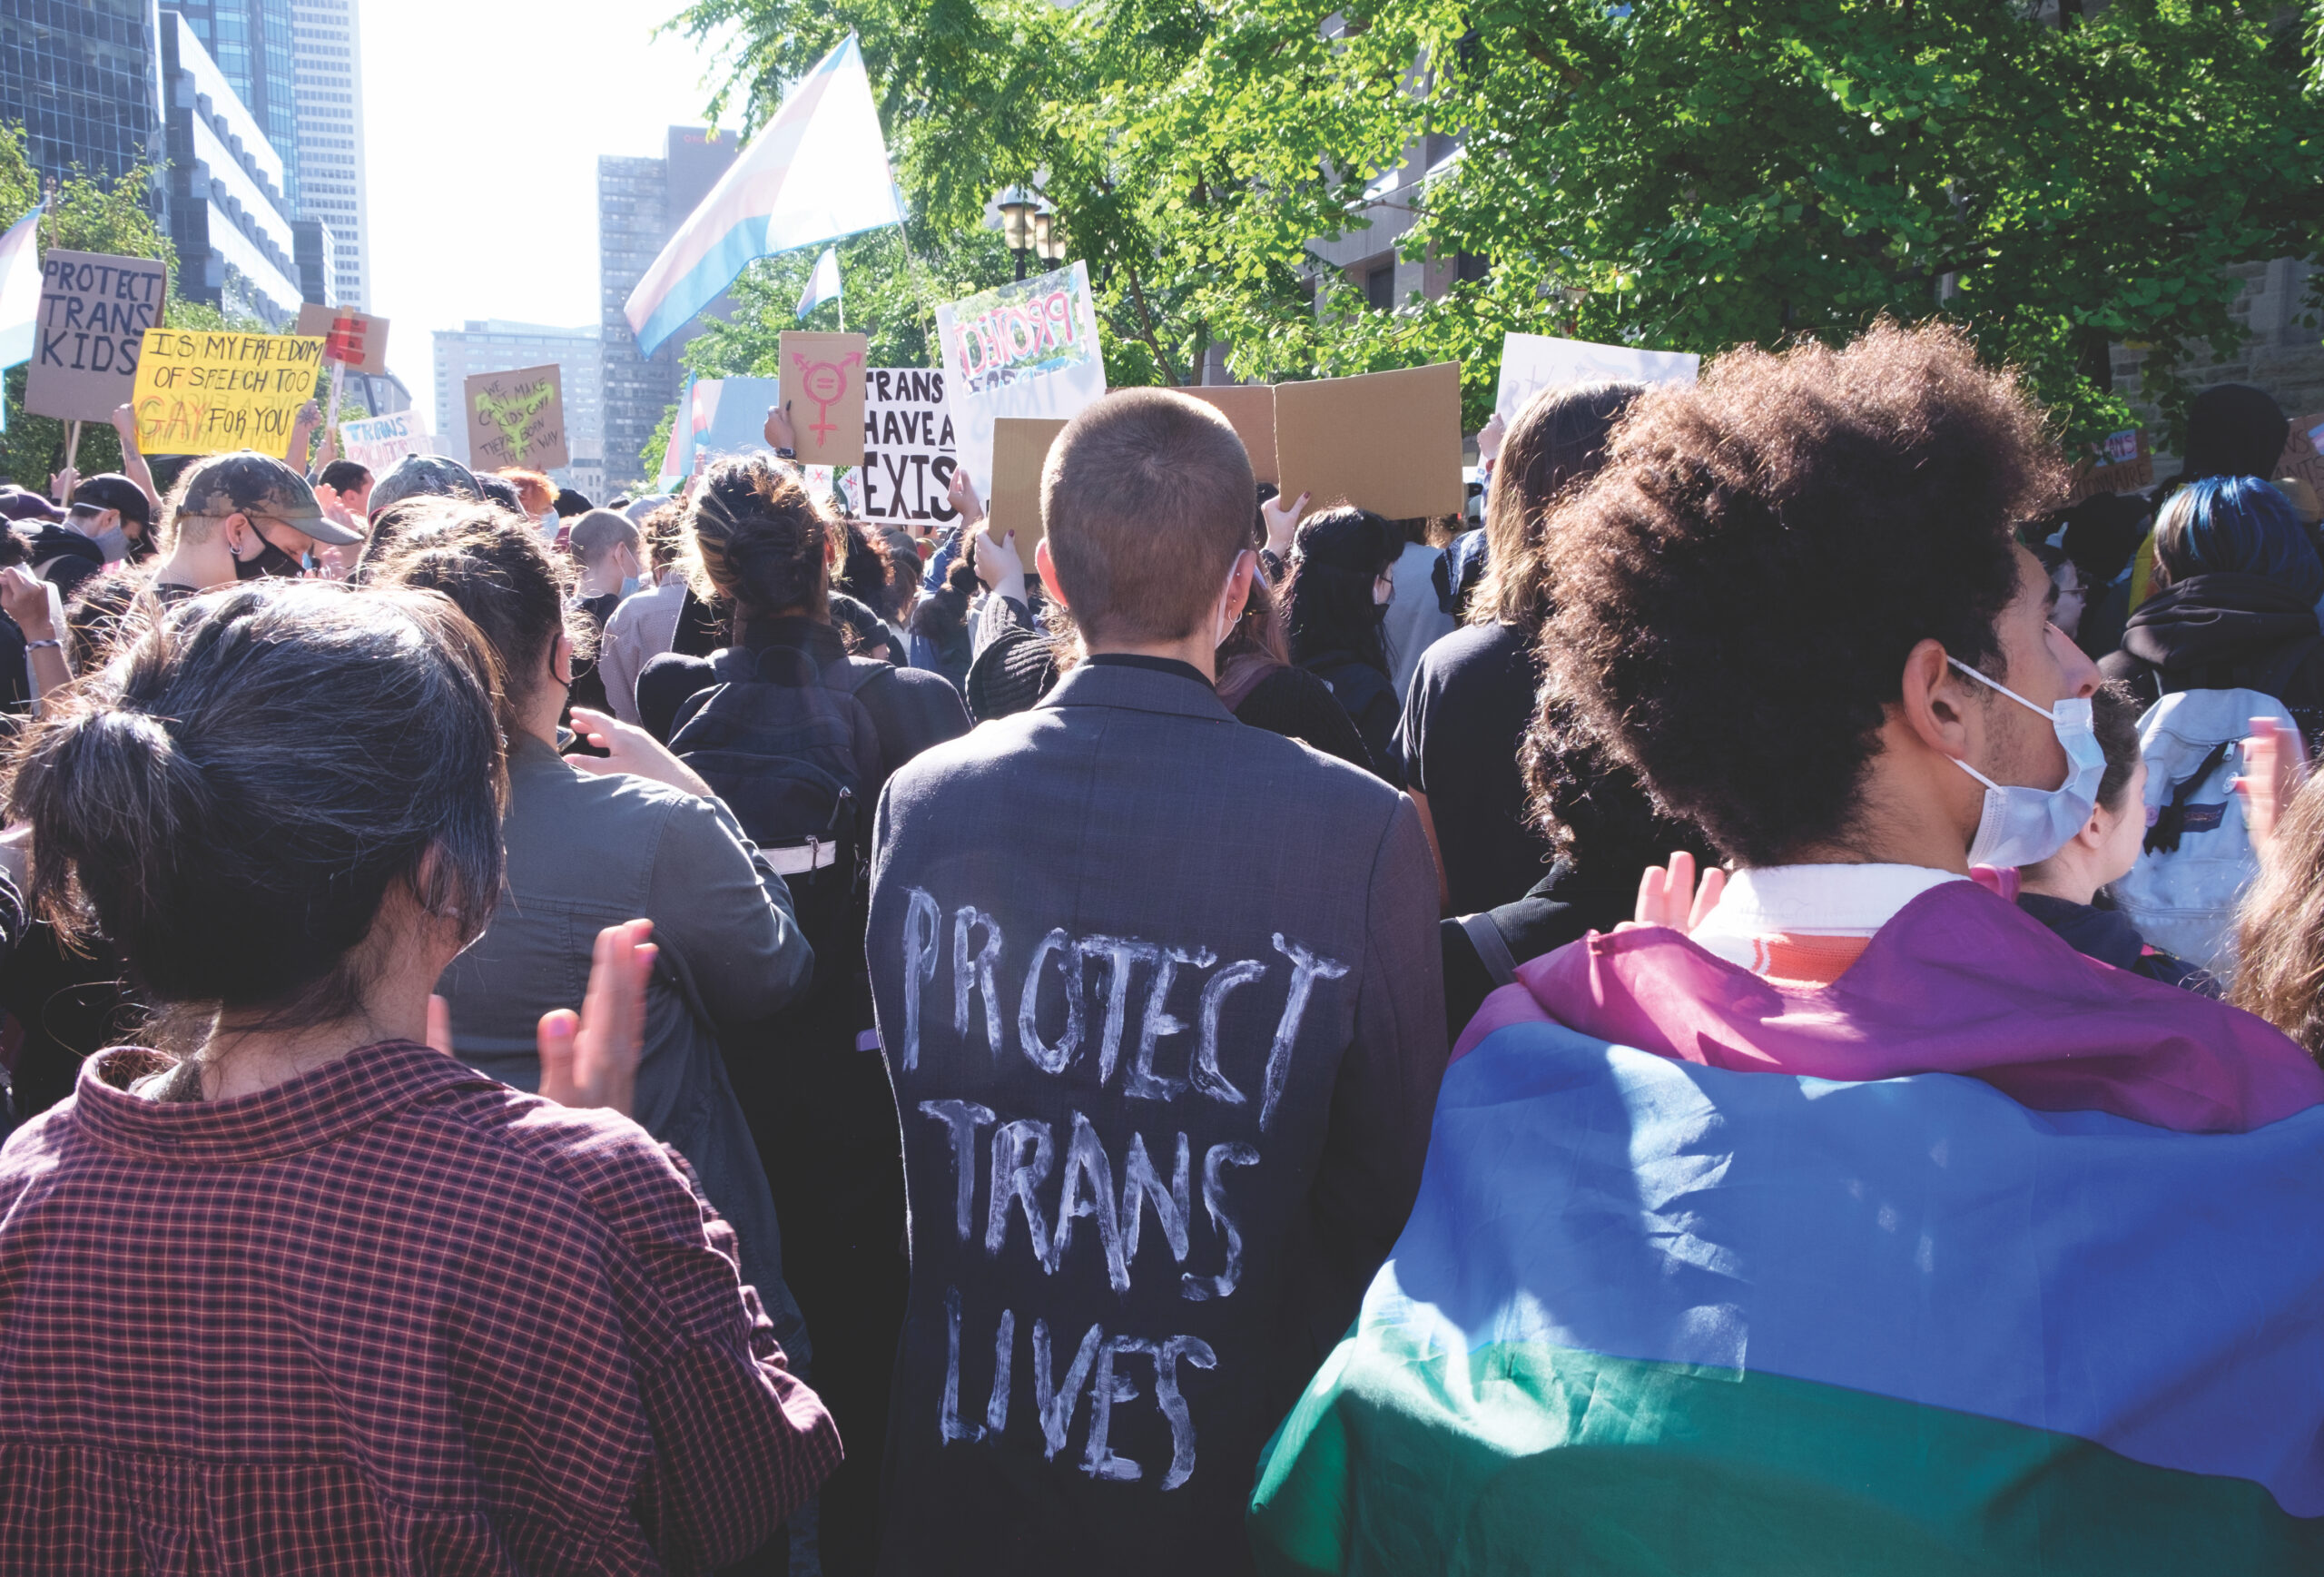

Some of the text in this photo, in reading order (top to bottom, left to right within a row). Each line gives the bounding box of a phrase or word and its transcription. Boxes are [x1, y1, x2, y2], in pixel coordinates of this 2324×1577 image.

[43, 260, 162, 301] PROTECT
[42, 293, 154, 337] TRANS
[41, 328, 139, 376] KIDS
[149, 332, 325, 367] IS MY FREEDOM
[153, 366, 310, 393] OF SPEECH TOO
[483, 379, 504, 397] WE
[514, 377, 546, 403] MAKE
[134, 395, 211, 441] GAY
[208, 408, 247, 439] FOR
[346, 417, 408, 441] TRANS
[864, 409, 955, 446] HAVE A
[537, 430, 558, 449] WAY
[862, 451, 960, 522] EXIS
[901, 885, 1352, 1131] PROTECT
[918, 1099, 1260, 1302] TRANS
[938, 1285, 1217, 1492] LIVES
